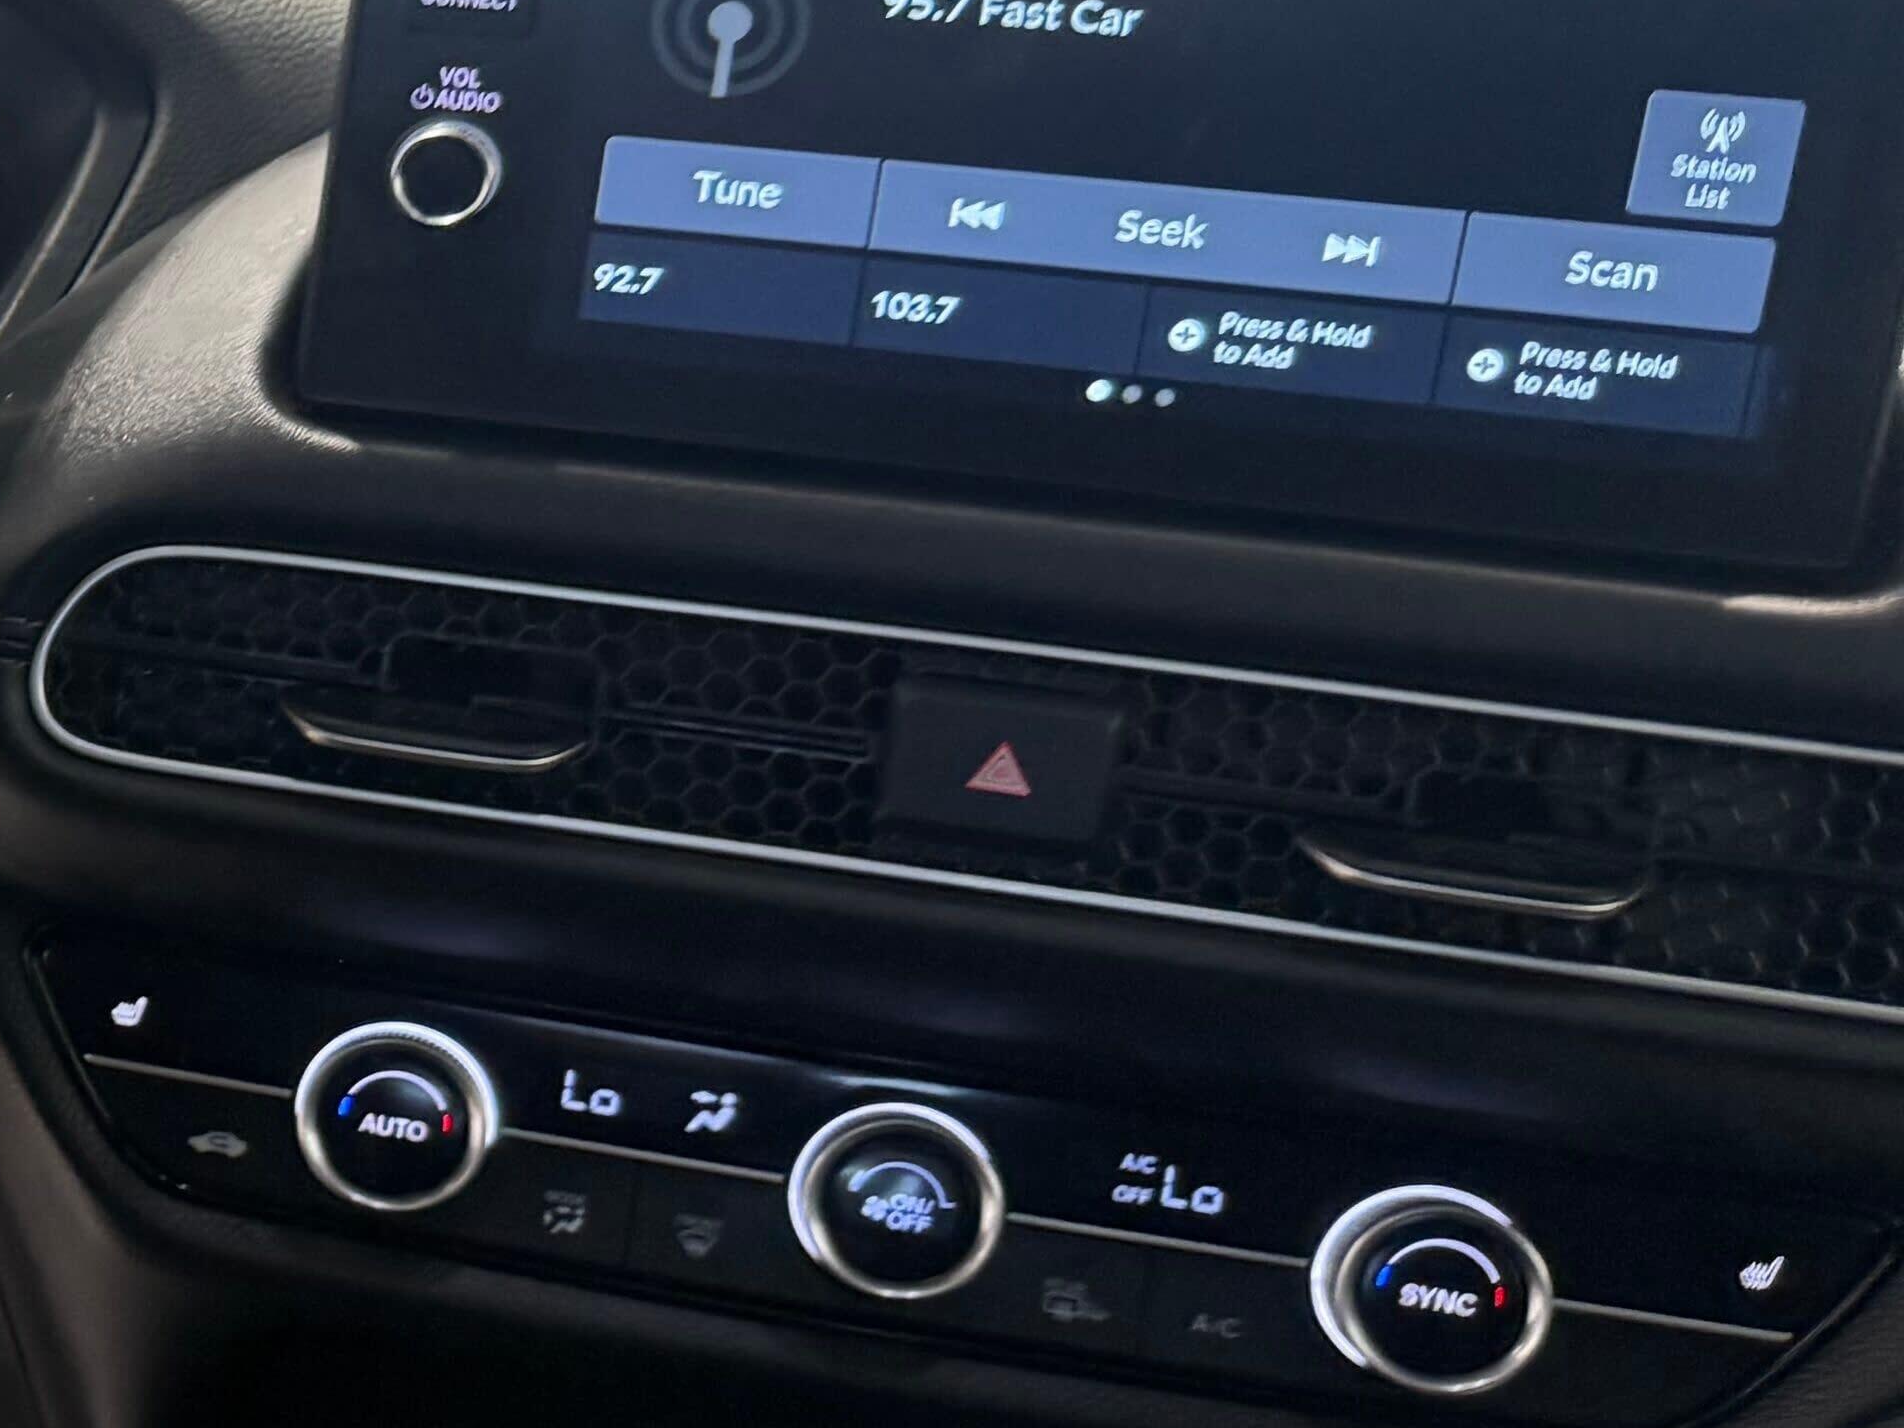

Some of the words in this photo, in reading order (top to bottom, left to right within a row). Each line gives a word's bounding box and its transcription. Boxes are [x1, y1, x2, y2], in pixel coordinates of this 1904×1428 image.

[439, 65, 481, 90] VOL
[433, 89, 503, 114] AUDIO
[1669, 152, 1758, 184] Station
[692, 169, 785, 210] Tune
[1683, 184, 1731, 212] List
[1114, 209, 1208, 252] Seek
[592, 262, 665, 296] 92.7
[1564, 249, 1660, 293] Scan
[870, 289, 962, 326] 103.7
[1216, 310, 1284, 342] Press
[1309, 319, 1374, 349] Hold
[1212, 338, 1241, 365] to
[1242, 342, 1296, 371] Add
[1519, 340, 1588, 372] Press
[1613, 349, 1680, 381] Hold
[1513, 369, 1542, 397] to
[1545, 373, 1599, 402] Add
[357, 1112, 429, 1144] AUTO
[1111, 1184, 1153, 1206] OFF
[885, 1211, 934, 1235] OFF
[1397, 1282, 1480, 1318] SYNC
